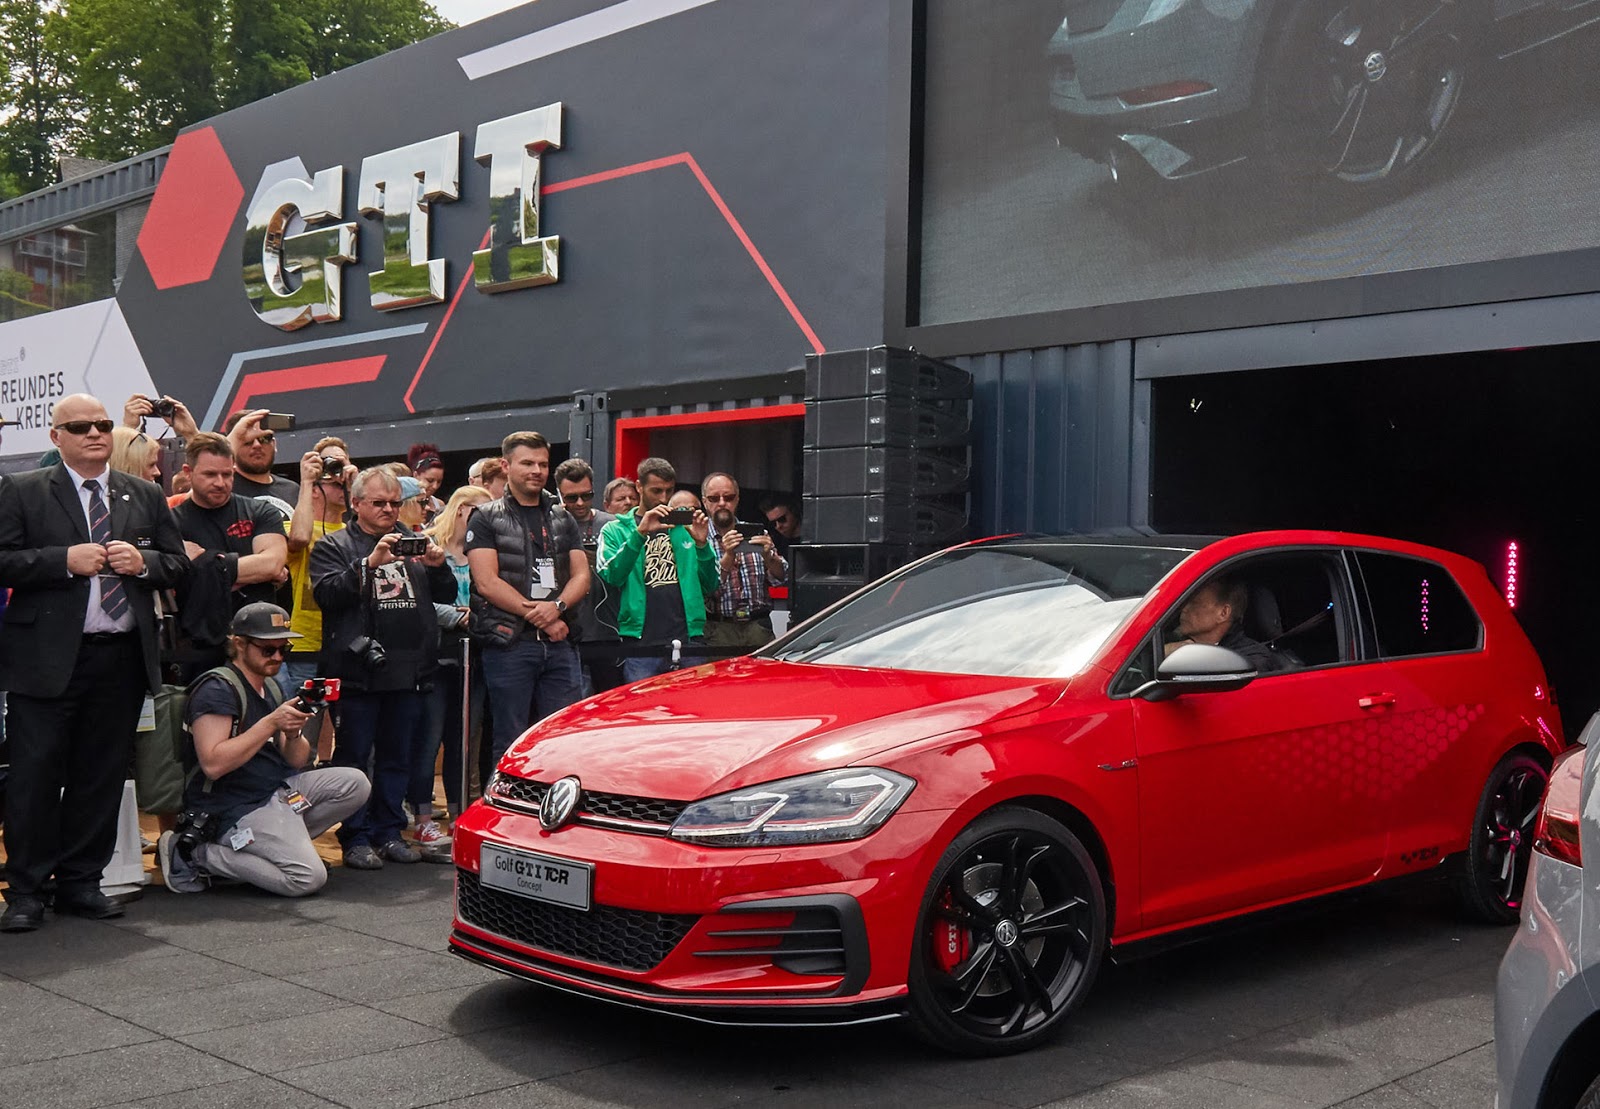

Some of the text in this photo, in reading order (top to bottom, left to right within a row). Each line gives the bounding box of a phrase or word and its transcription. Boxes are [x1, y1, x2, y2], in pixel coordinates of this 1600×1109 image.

[242, 101, 563, 331] GTI
[1, 371, 64, 404] REUNDES
[495, 855, 570, 885] Golf GTI TCR
[516, 877, 543, 893] Concept
